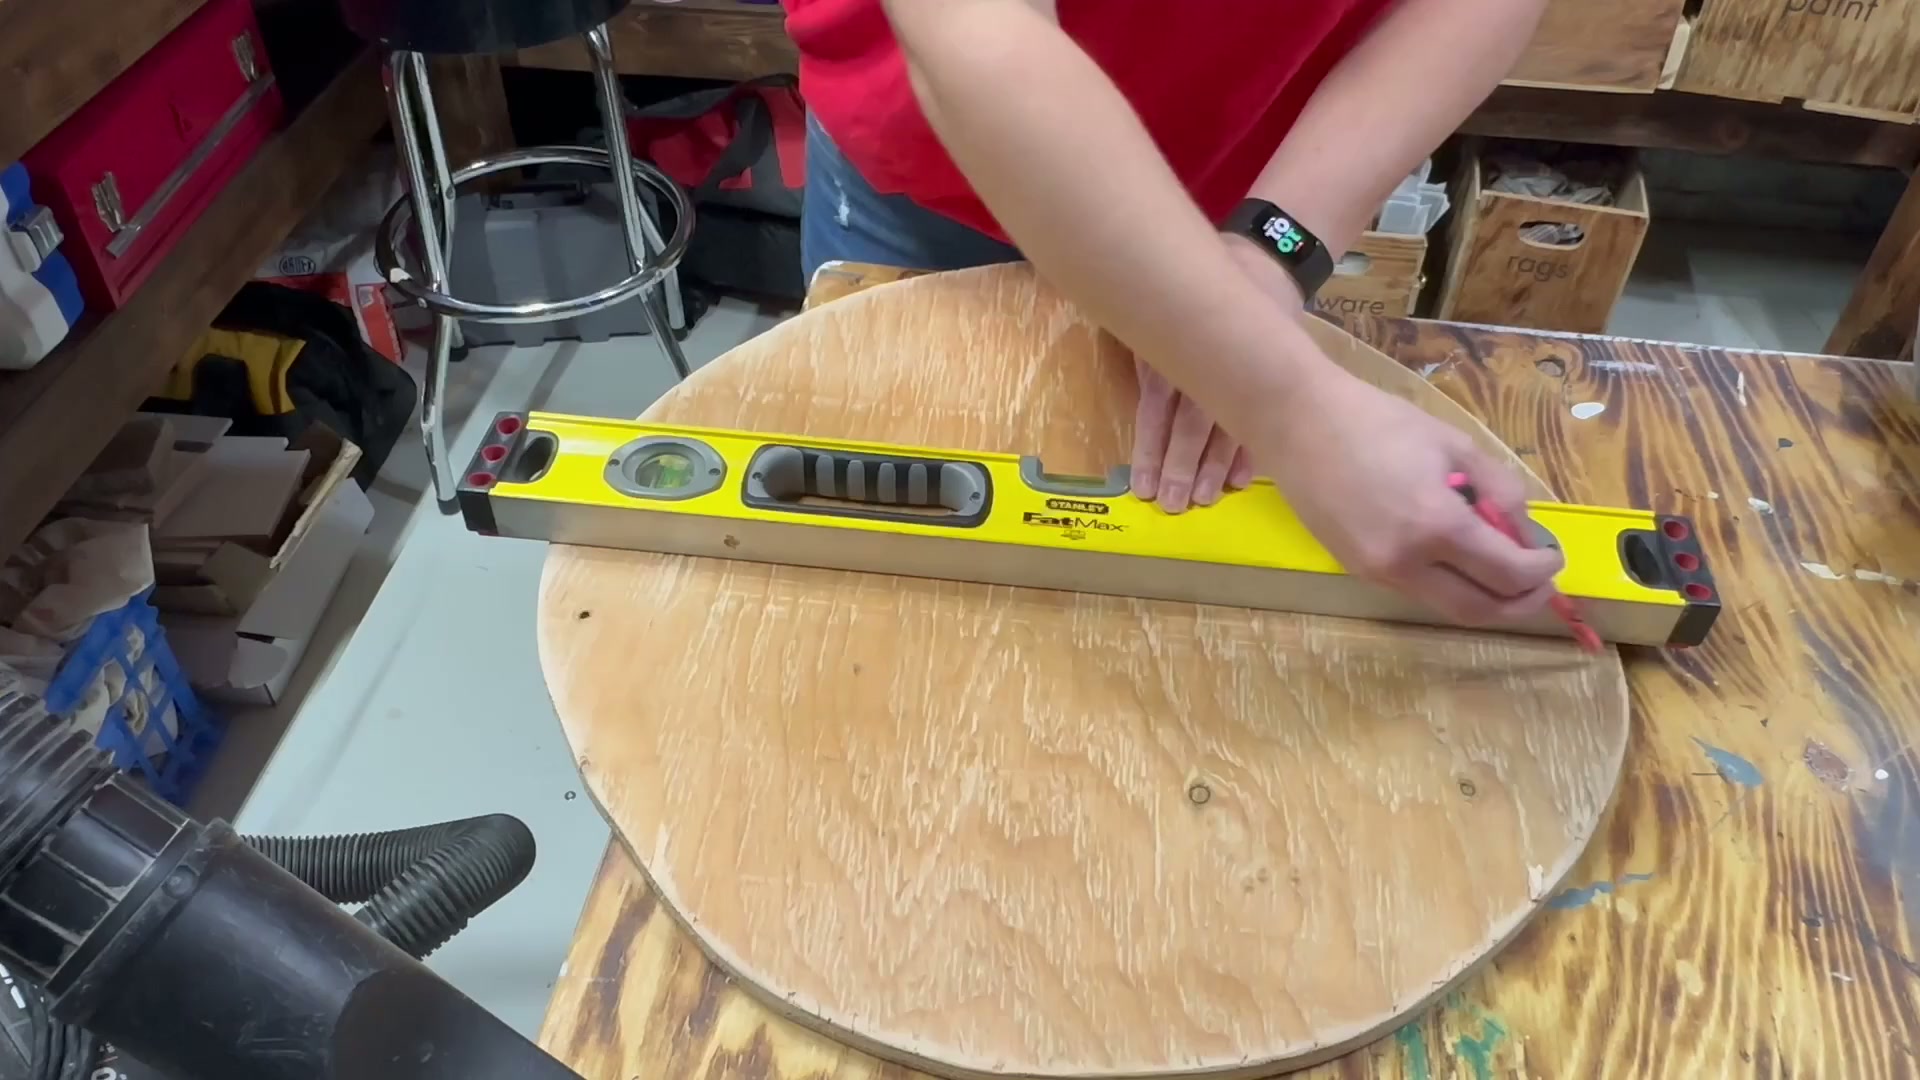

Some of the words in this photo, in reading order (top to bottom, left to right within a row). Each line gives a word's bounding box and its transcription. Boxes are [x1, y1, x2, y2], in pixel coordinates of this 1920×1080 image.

[1781, 0, 1879, 22] paint
[1506, 255, 1569, 282] rags
[1317, 298, 1385, 315] ware
[1049, 500, 1107, 513] STANLEY
[1023, 511, 1124, 532] FatMax
